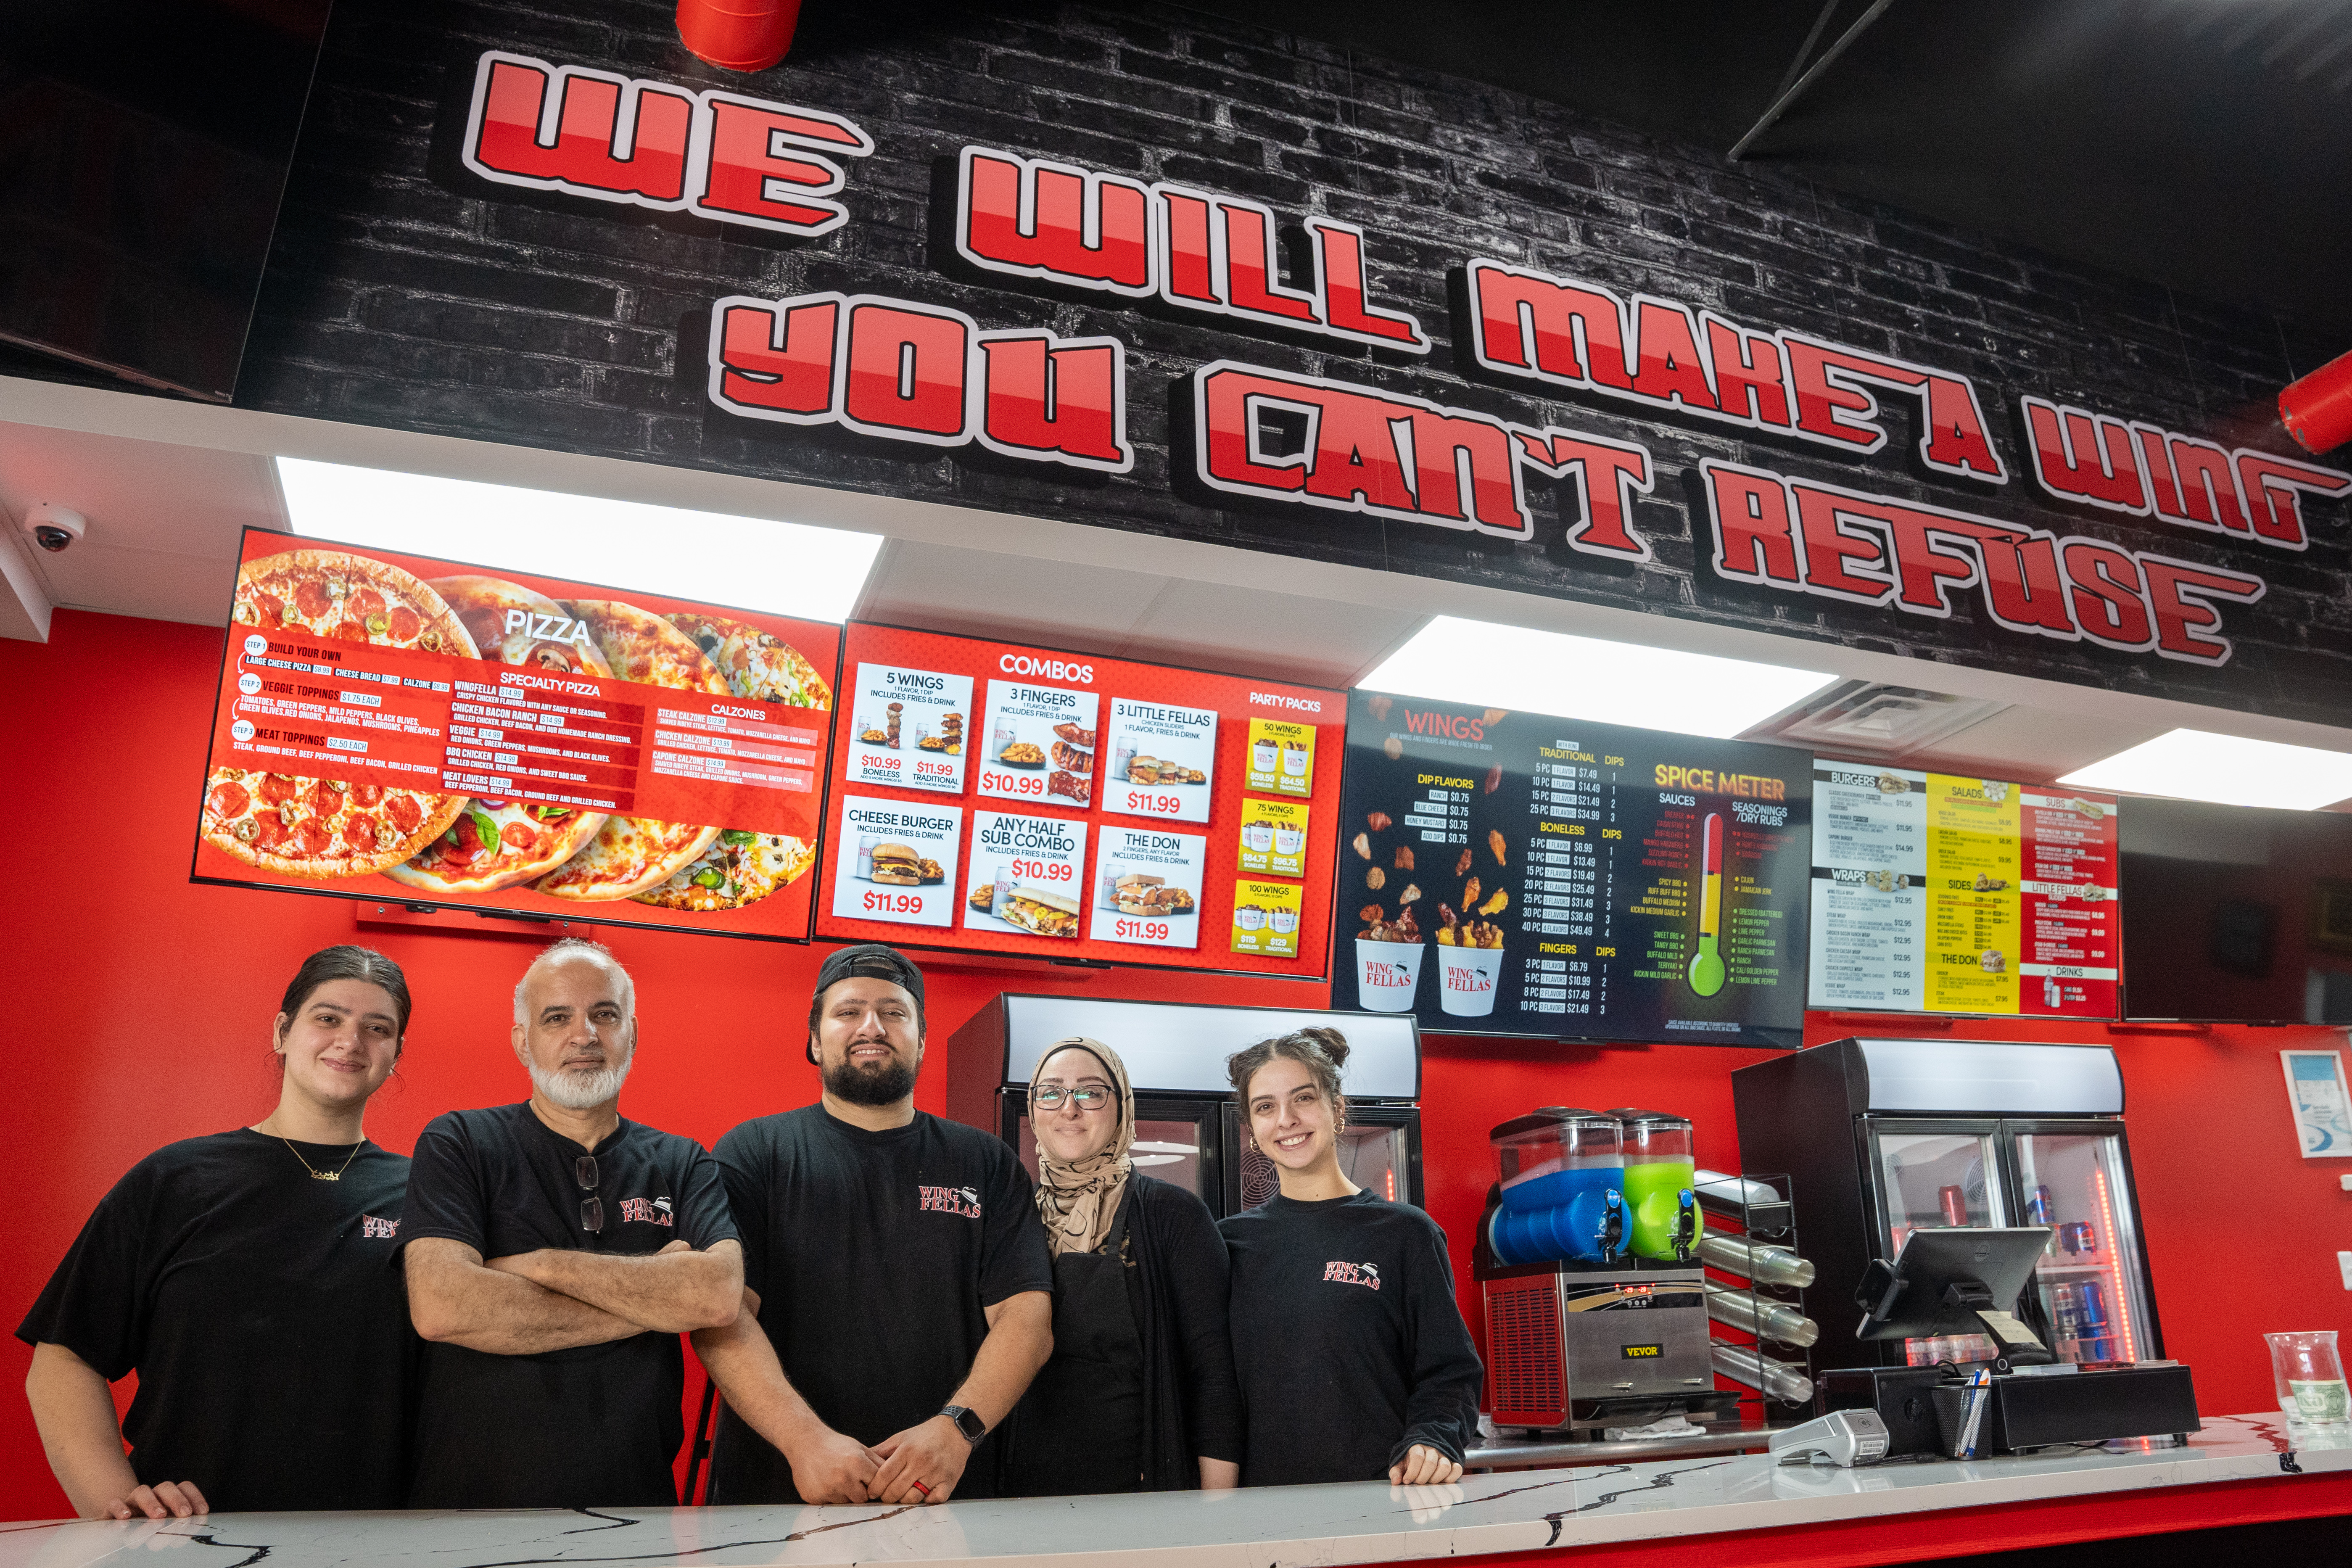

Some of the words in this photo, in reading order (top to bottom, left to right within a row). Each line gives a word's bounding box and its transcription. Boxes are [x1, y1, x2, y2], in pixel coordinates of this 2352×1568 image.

[462, 50, 874, 237] WE
[956, 145, 1431, 354] WILL
[1467, 258, 1928, 454] MAKE
[1921, 373, 2008, 484] A
[2021, 394, 2352, 552] WING
[708, 291, 1134, 473] YOU
[1194, 359, 1655, 562] CAN'T
[1699, 458, 2266, 667] REFUSE
[505, 609, 591, 646] PIZZA
[268, 642, 294, 655] BUILD
[297, 646, 319, 658] YOUR
[321, 649, 341, 661] OWN
[245, 656, 267, 665] LARGE
[267, 658, 292, 669] CHEESE
[293, 662, 311, 672] PIZZA
[335, 668, 359, 678] CHEESE
[360, 672, 381, 681] BREAD
[383, 675, 399, 684] $7.99
[404, 678, 431, 689] CALZONE
[999, 654, 1093, 684] COMBOS
[454, 680, 496, 695] WINGFELLA
[501, 688, 521, 697] $14.99
[500, 672, 565, 691] SPECIALTY
[566, 681, 600, 697] PIZZA
[887, 672, 895, 684] 5
[898, 673, 943, 690] WINGS
[263, 681, 294, 694] VEGGIE
[297, 685, 339, 700] TOPPINGS
[342, 693, 360, 703] $1.75
[362, 696, 380, 705] EACH
[871, 689, 905, 700] INCLUDES
[907, 694, 927, 703] FRIES
[934, 697, 955, 707] DRINK
[1010, 688, 1018, 700] 3
[1021, 689, 1075, 707] FINGERS
[1249, 692, 1286, 707] PARTY
[1286, 697, 1321, 713] PACKS
[451, 702, 484, 715] CHICKEN
[485, 707, 510, 718] BACON
[512, 710, 537, 722] RANCH
[541, 715, 562, 725] $14.99
[711, 704, 766, 721] CALZONES
[1117, 704, 1124, 715] 3
[1127, 705, 1165, 721] LITTLE
[1168, 710, 1210, 726] FELLAS
[449, 724, 475, 736] VEGGIE
[480, 729, 501, 739] $14.99
[1275, 724, 1301, 735] WINGS
[1404, 709, 1484, 741] WINGS
[256, 728, 280, 740] MEAT
[283, 731, 325, 746] TOPPINGS
[329, 738, 348, 748] $2.50
[349, 741, 367, 750] EACH
[233, 742, 254, 752] STEAK,
[256, 744, 280, 755] GROUND
[281, 747, 297, 757] BEEF,
[298, 750, 314, 758] BEEF
[314, 752, 348, 763] PEPPERONI,
[350, 756, 365, 765] BEEF
[365, 758, 387, 768] BACON,
[388, 761, 412, 771] GRILLED
[412, 764, 438, 774] CHICKEN
[861, 754, 901, 770] $10.99
[1539, 747, 1595, 763] TRADITIONAL
[1605, 755, 1624, 766] DIPS
[863, 767, 900, 778] BONELESS
[917, 760, 953, 776] $11.99
[1536, 762, 1540, 772] 5
[1542, 763, 1550, 773] PC
[1557, 767, 1573, 775] FLAVOR
[1579, 767, 1597, 779] $7.49
[1613, 772, 1616, 781] 1
[913, 773, 959, 785] TRADITIONAL
[982, 771, 1043, 795] $10.99
[1418, 774, 1434, 784] DIP
[1434, 776, 1474, 789] FLAVORS
[1655, 764, 1714, 792] SPICE
[1718, 772, 1784, 800] METER
[1831, 771, 1875, 788] BURGERS
[1450, 791, 1469, 803] $0.75
[1659, 792, 1695, 806] SAUCES
[1952, 786, 1982, 799] SALADS
[1127, 790, 1180, 813] $11.99
[1732, 801, 1787, 818] SEASONINGS
[2046, 796, 2065, 809] SUBS
[849, 809, 898, 825] CHEESE
[901, 815, 953, 831] BURGER
[993, 817, 1026, 832] ANY
[1028, 820, 1066, 836] HALF
[1449, 818, 1468, 830] $0.75
[1736, 812, 1759, 824] /DRY
[1760, 814, 1783, 826] RUBS
[1540, 822, 1585, 835] BONELESS
[1602, 829, 1622, 839] DIPS
[981, 829, 1011, 845] SUB
[1014, 833, 1074, 852] COMBO
[1125, 833, 1149, 847] THE
[1152, 836, 1180, 850] DON
[1012, 858, 1072, 882] $10.99
[1831, 868, 1866, 883] WRAPS
[1263, 885, 1289, 895] WINGS
[1948, 879, 1971, 890] SIDES
[2032, 883, 2055, 895] LITTLE
[2056, 884, 2082, 897] FELLAS
[863, 890, 923, 914] $11.99
[1642, 897, 1662, 905] BUFFALO
[1539, 942, 1576, 954] FINGERS
[1596, 946, 1616, 957] DIPS
[1941, 953, 1957, 964] THE
[1959, 955, 1977, 965] DON
[1366, 961, 1392, 975] WING
[1447, 966, 1473, 980] WING
[2056, 966, 2083, 977] DRINKS
[1366, 972, 1411, 987] FELLAS
[1447, 977, 1491, 992] FELLAS
[919, 1186, 959, 1201] WING
[620, 1198, 652, 1212] WING
[920, 1197, 981, 1218] FELLAS
[1326, 1262, 1359, 1274] WING
[1323, 1270, 1380, 1290] FELLAS
[1626, 1346, 1658, 1357] VEVOR
